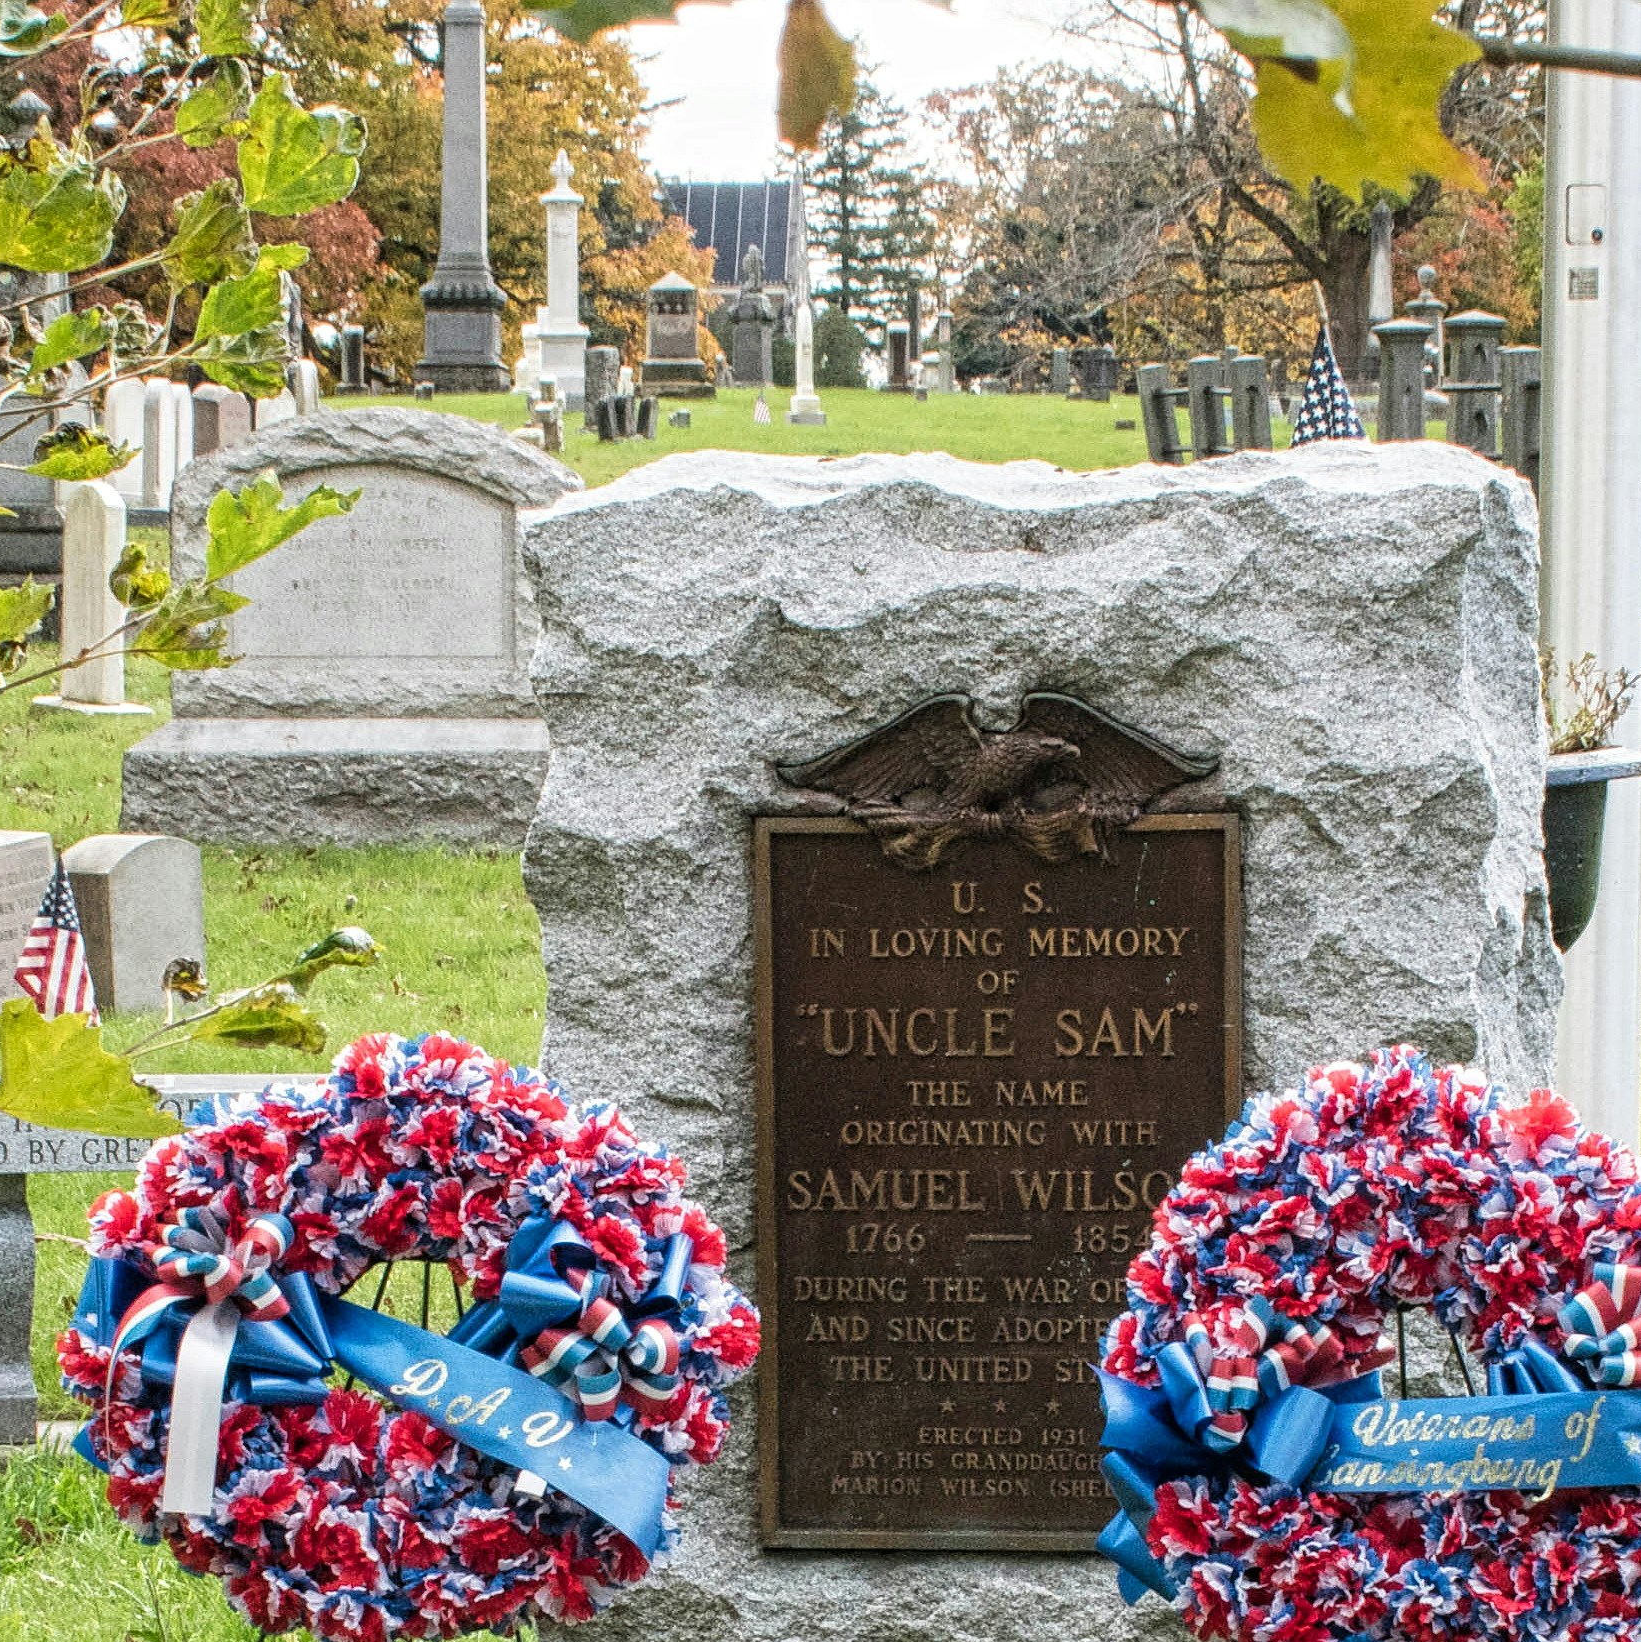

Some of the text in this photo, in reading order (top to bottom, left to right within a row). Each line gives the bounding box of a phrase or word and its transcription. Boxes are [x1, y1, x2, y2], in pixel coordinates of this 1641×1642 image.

[951, 881, 1054, 914] U. S.
[809, 927, 1190, 958] IN LOVING MEMORY
[976, 969, 1019, 995] OF
[796, 1002, 1200, 1058] "UNCLE SAM"
[906, 1080, 1090, 1107] THE NAME
[840, 1120, 1159, 1147] ORIGINATING WITH
[28, 1139, 66, 1165] BY
[81, 1137, 155, 1166] GRE
[786, 1168, 1175, 1212] SAMUEL WILSO
[846, 1222, 927, 1254] 1766
[1072, 1223, 1150, 1254] 1854
[794, 1276, 1128, 1304] DURING THE WAR OF
[805, 1314, 1110, 1344] AND SINCE ADOPTE
[829, 1355, 895, 1384] THE
[916, 1355, 1033, 1385] UNITED
[917, 1426, 1087, 1446] ERECTED 1931
[1353, 1396, 1607, 1462] Veterans of
[849, 1450, 1104, 1472] BY HIS GRANDDAUGH
[830, 1474, 921, 1496] MARION
